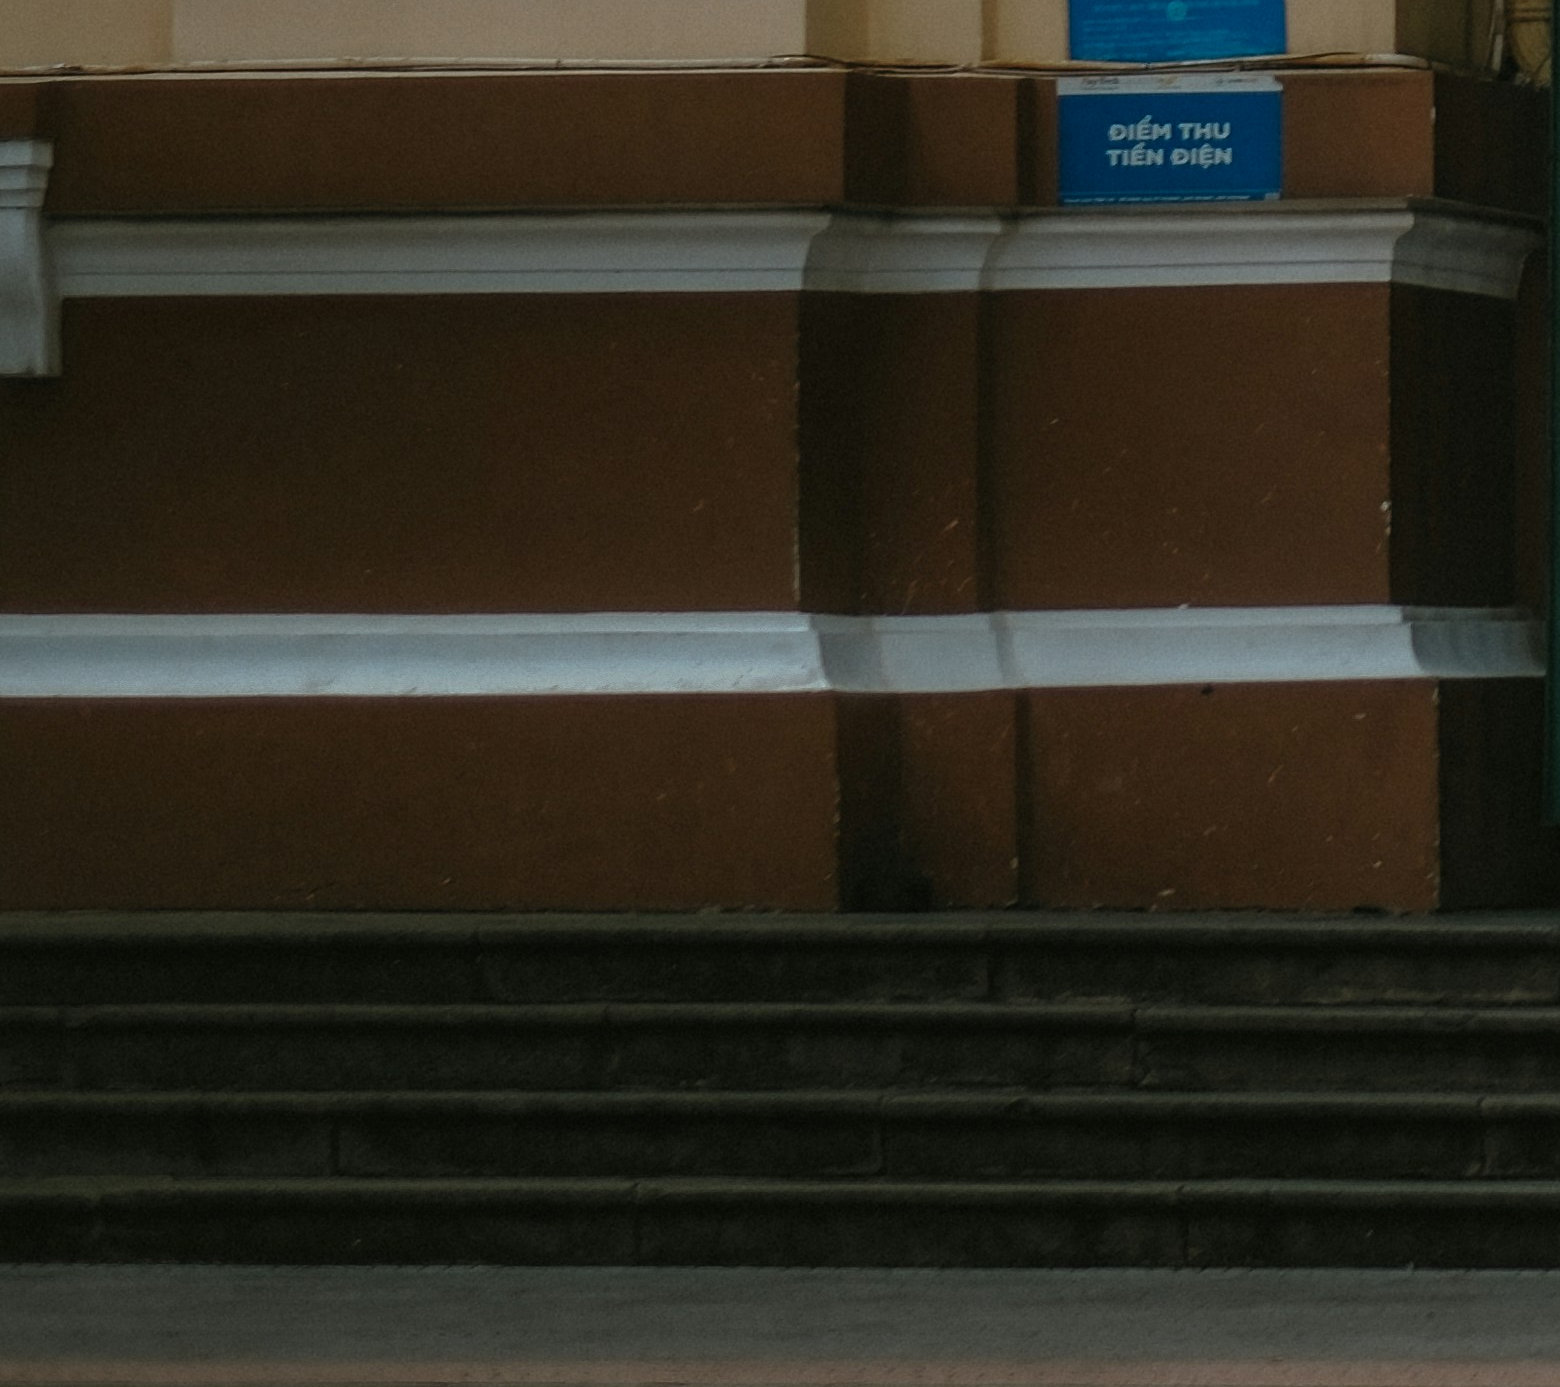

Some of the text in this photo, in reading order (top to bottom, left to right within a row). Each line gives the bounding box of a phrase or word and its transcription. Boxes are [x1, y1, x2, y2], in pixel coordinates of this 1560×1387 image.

[1108, 114, 1232, 142] ĐIỂM THU
[1170, 142, 1234, 169] ĐIỆN
